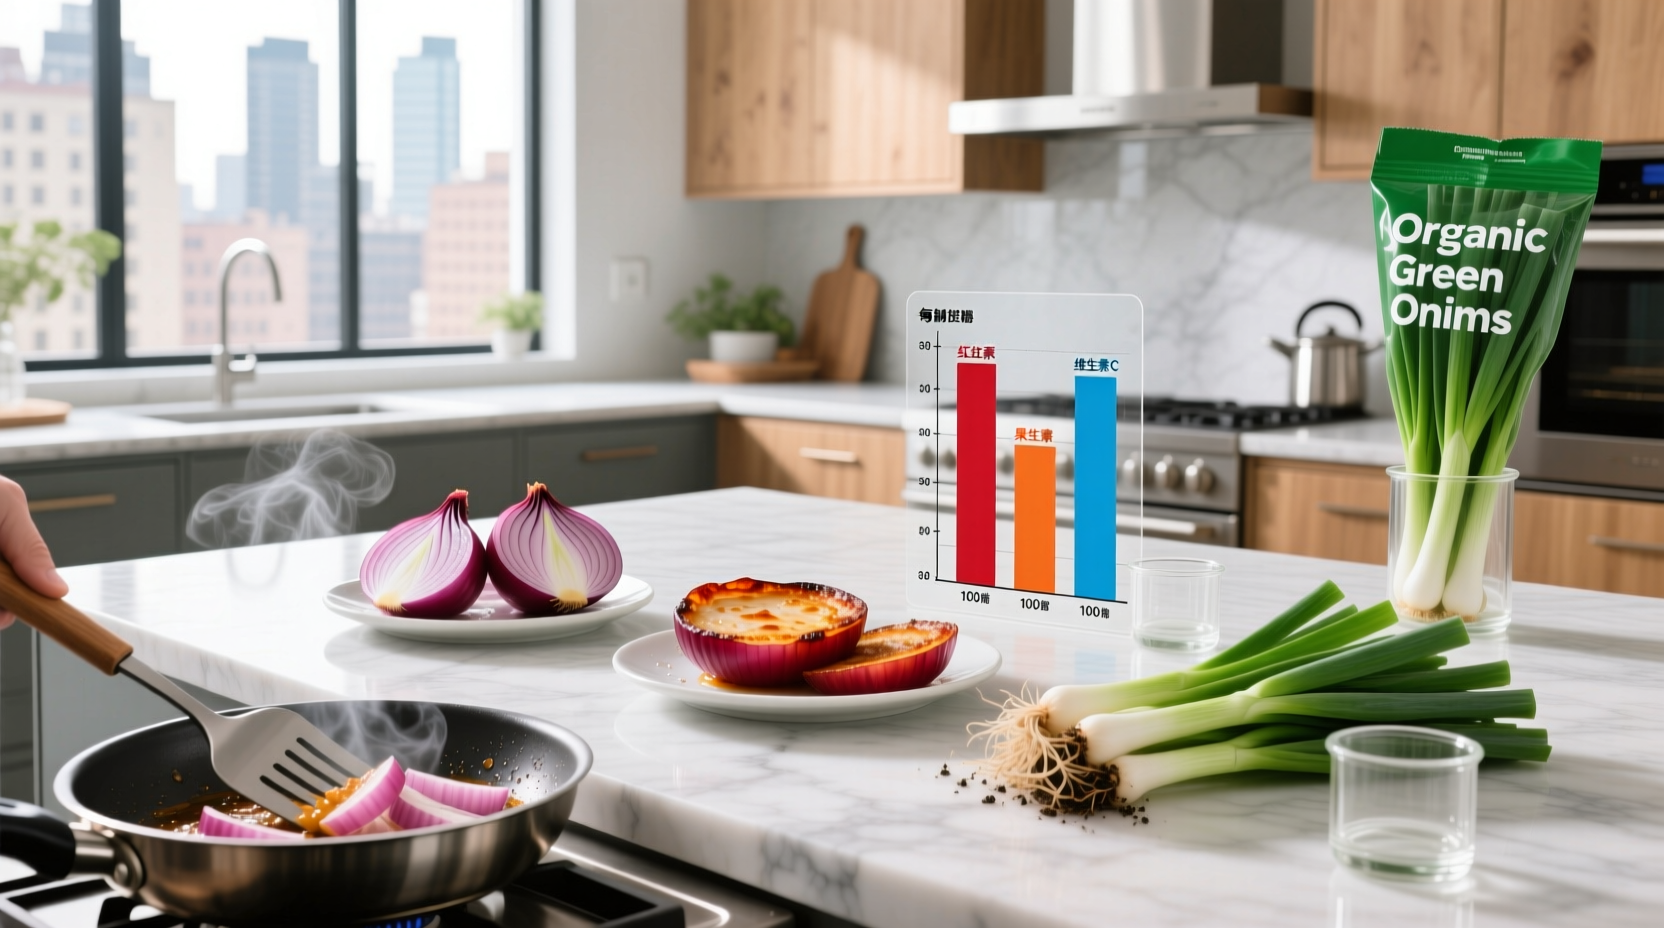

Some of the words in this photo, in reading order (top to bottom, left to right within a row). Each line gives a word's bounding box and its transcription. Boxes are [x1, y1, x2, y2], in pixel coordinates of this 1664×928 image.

[1392, 213, 1548, 256] Organic
[1390, 254, 1504, 293] Green
[1391, 293, 1512, 335] Onims
